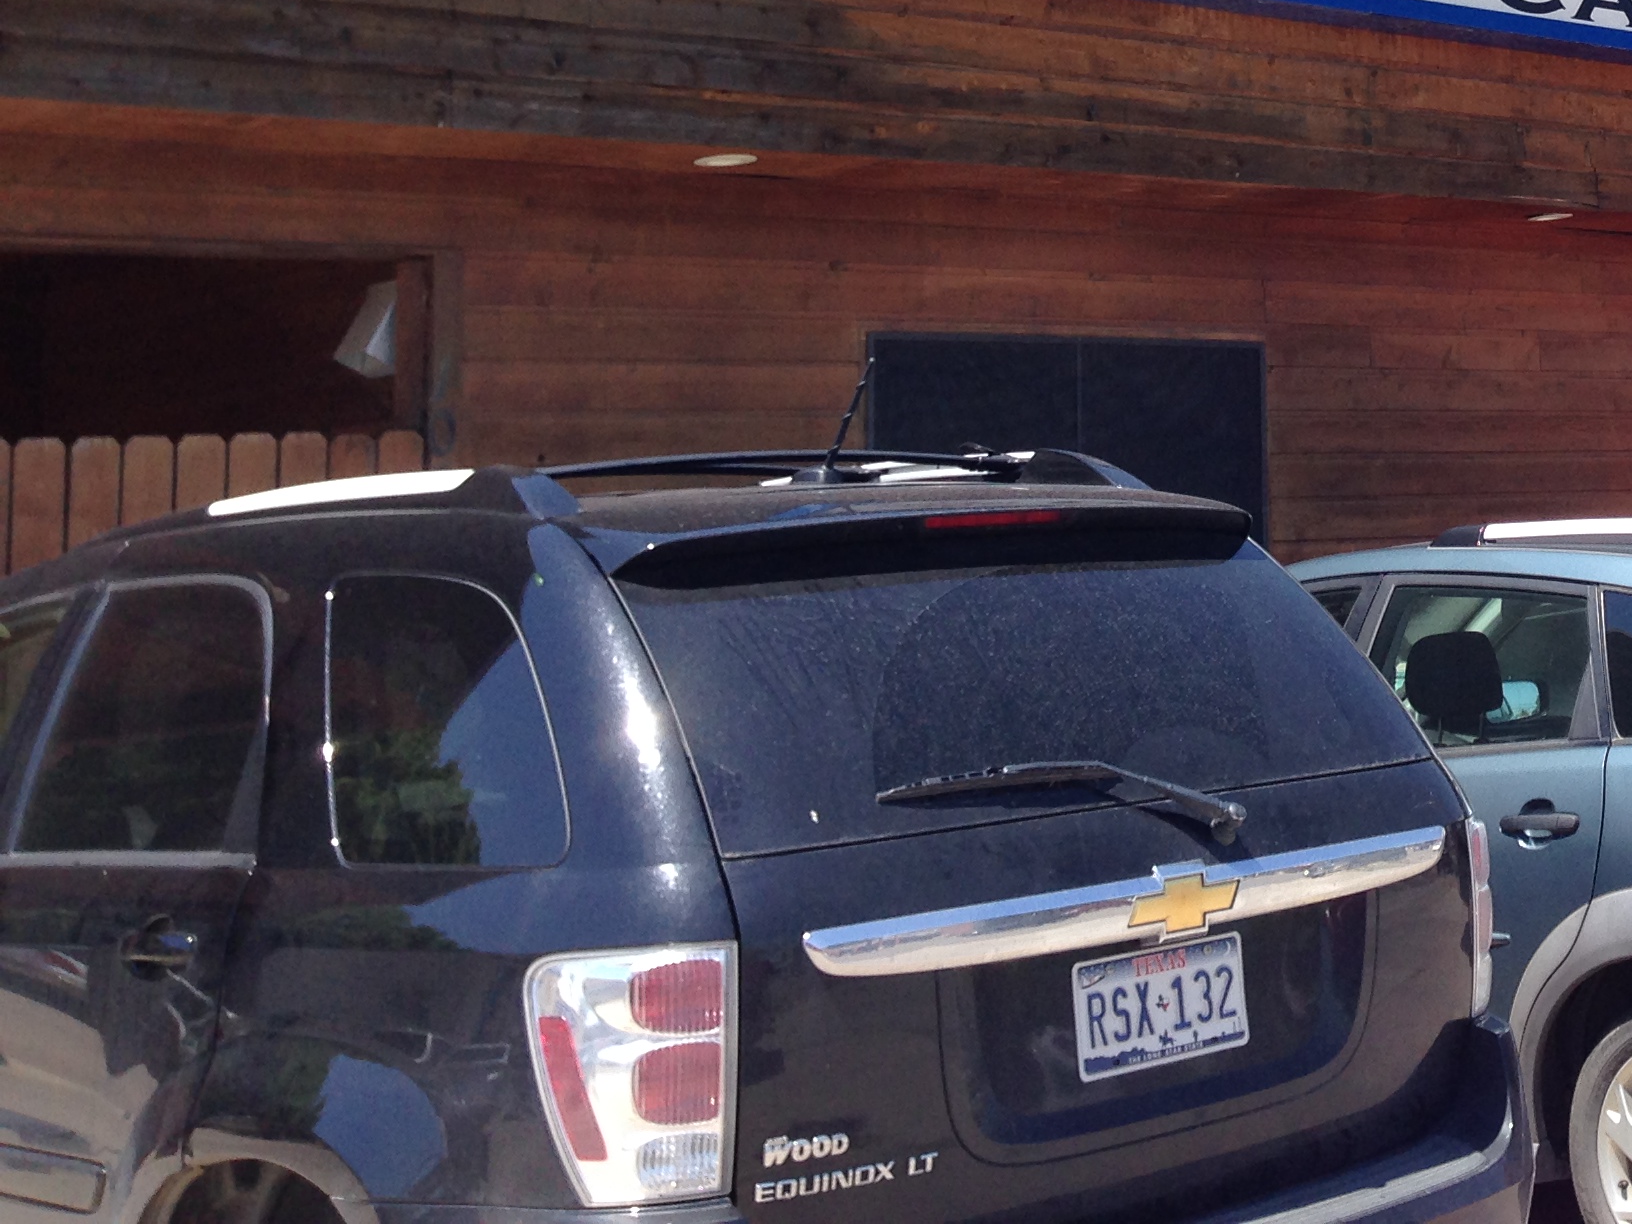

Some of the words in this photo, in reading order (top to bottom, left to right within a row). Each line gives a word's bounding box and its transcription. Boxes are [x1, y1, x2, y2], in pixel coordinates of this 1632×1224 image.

[1131, 948, 1187, 978] TEXAS
[763, 1133, 849, 1168] WOOD
[755, 1160, 895, 1203] EQUINOX
[908, 1151, 939, 1176] LT
